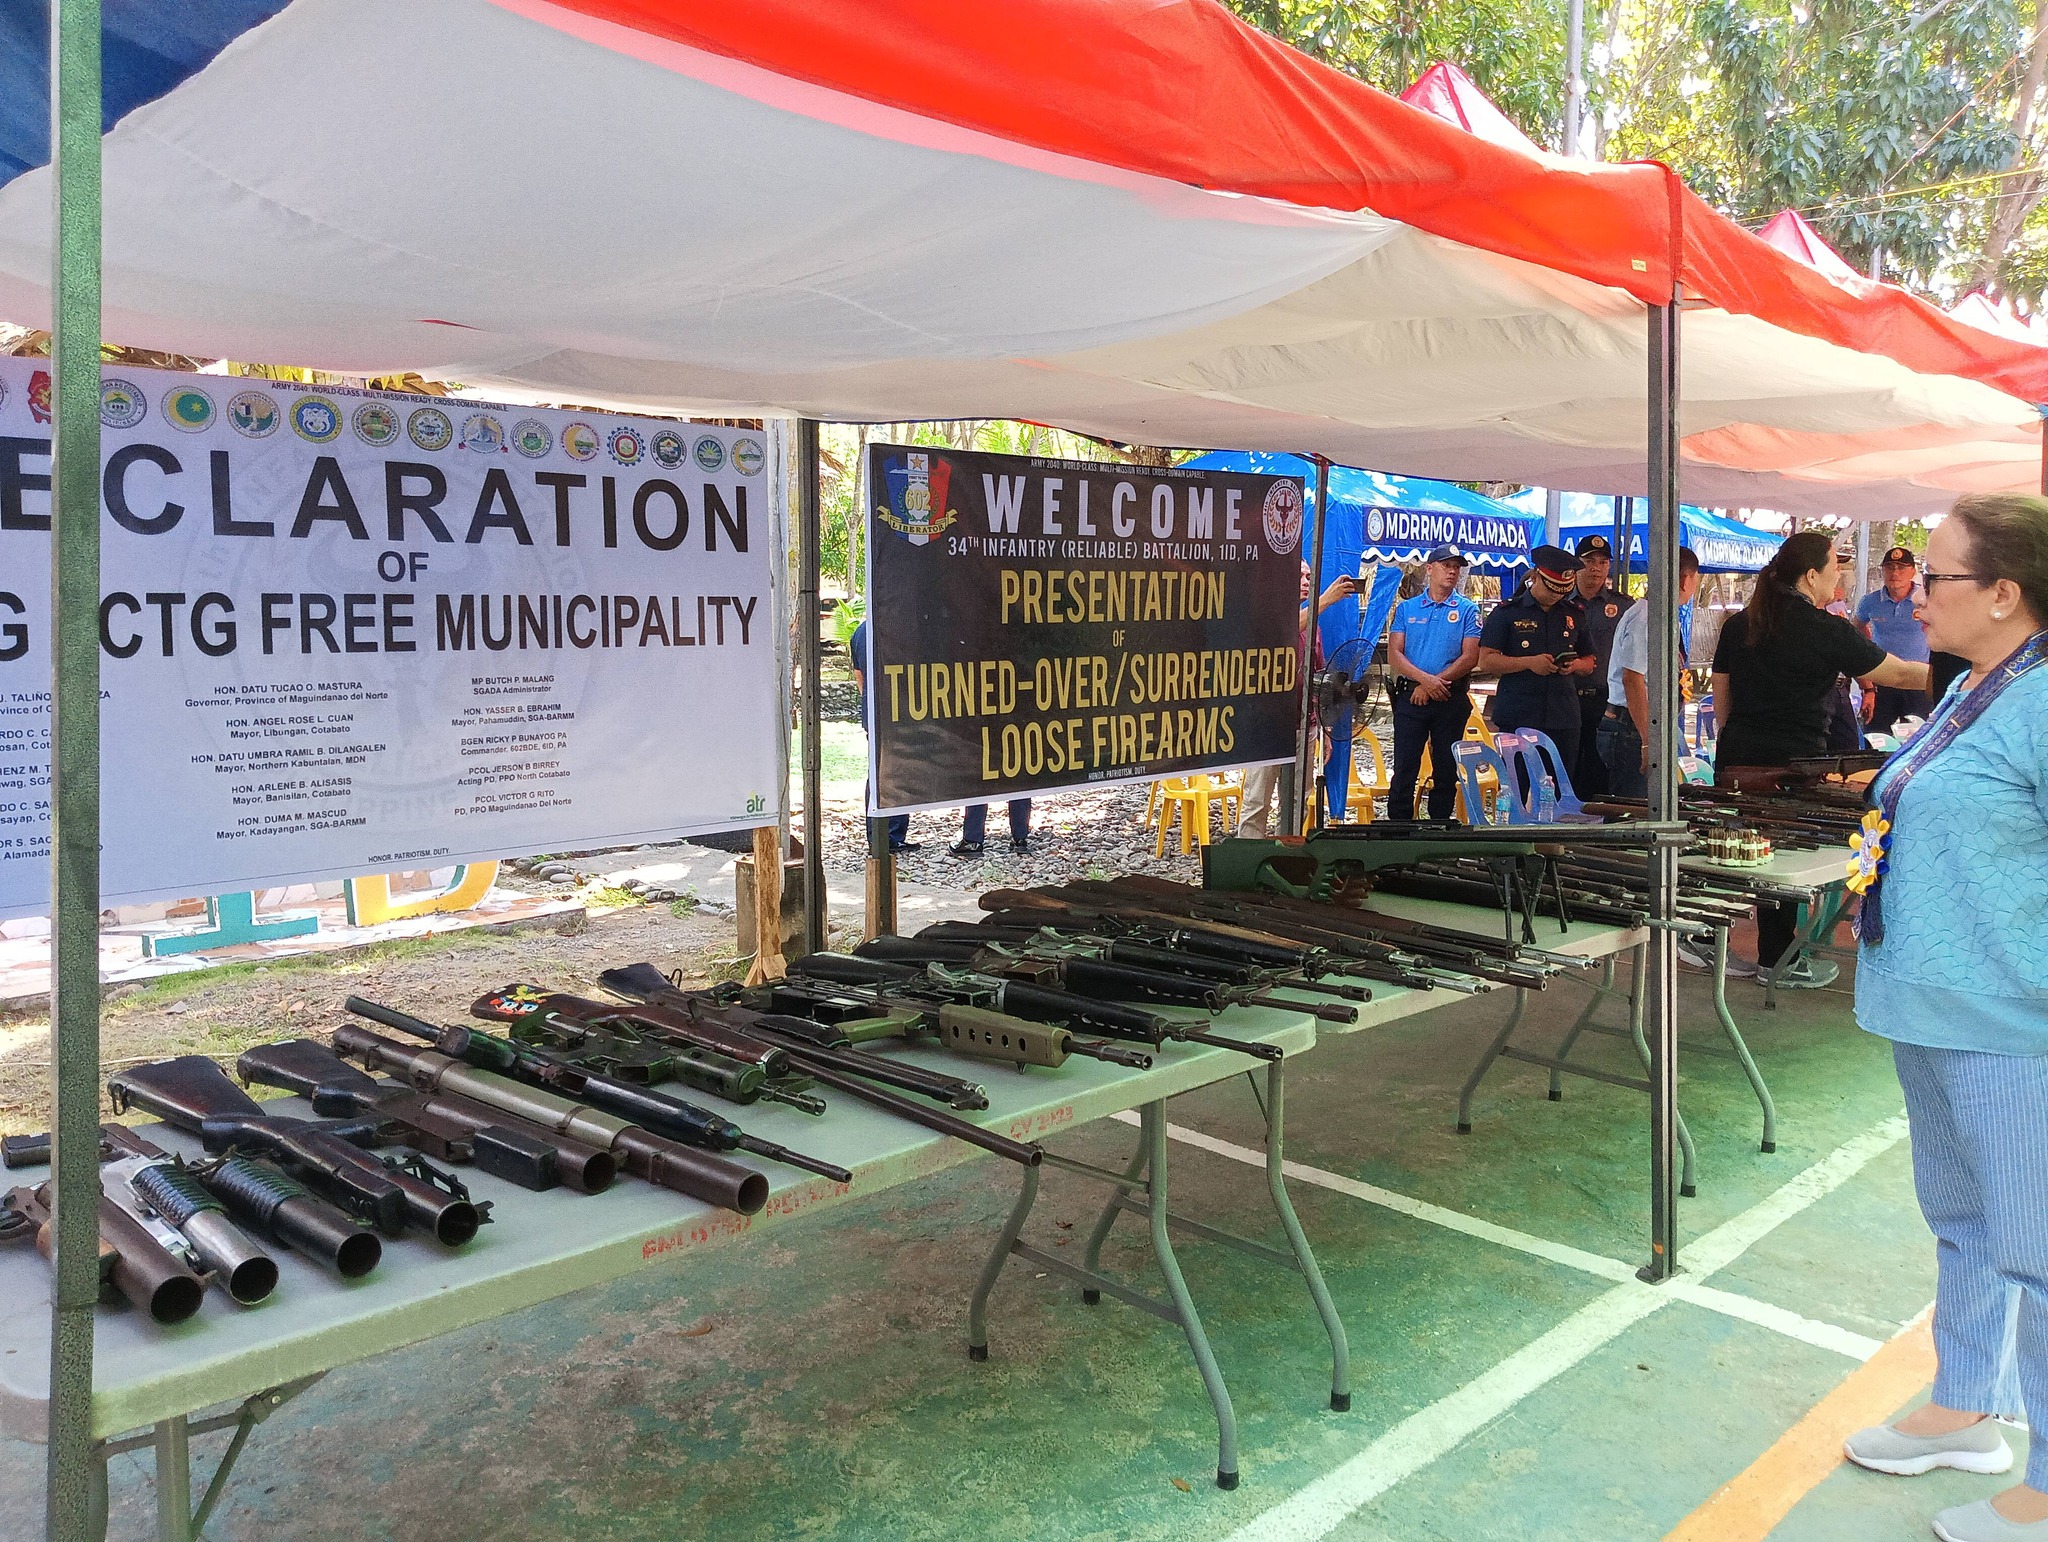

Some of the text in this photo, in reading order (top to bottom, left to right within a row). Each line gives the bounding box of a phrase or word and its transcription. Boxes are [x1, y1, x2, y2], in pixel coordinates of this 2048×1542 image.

[1031, 459, 1045, 468] ARMY
[1, 436, 748, 552] ECLARATION
[905, 489, 931, 511] 602
[982, 474, 1242, 540] WELCOME
[892, 522, 944, 533] LIBERATOR
[1385, 512, 1451, 542] MDRRMO
[1457, 519, 1527, 549] ALAMADA
[948, 537, 1259, 561] 34TH INFANTRY (RELIABLE) BATTALION, 1ID, PA
[378, 551, 429, 582] OF
[1001, 570, 1226, 625] PRESENTATION
[99, 591, 237, 658] CTG
[261, 592, 416, 653] FREE
[436, 593, 757, 652] MUNICIPALITY
[1112, 630, 1125, 647] OF
[523, 675, 554, 683] MALANG
[884, 646, 1296, 722] TURNED-OVER/SURRENDERED
[214, 686, 238, 694] HON.
[242, 685, 267, 694] DATU
[305, 684, 315, 692] O.
[318, 682, 362, 691] MASTURA
[185, 698, 232, 707] Governor,
[235, 696, 275, 705] Province
[290, 694, 348, 704] Maguindanao
[366, 692, 388, 700] Norte
[33, 705, 42, 713] of
[527, 704, 561, 712] EBRAHIM
[226, 720, 250, 728] HON.
[253, 718, 286, 726] ANGEL
[289, 716, 314, 724] ROSE
[327, 714, 354, 722] CUAN
[452, 719, 476, 727] Mayor,
[528, 713, 575, 721] SGA-BARMM
[231, 725, 350, 740] Mayor, Libungan, Cotabato
[519, 733, 555, 742] BUNAYOG
[981, 705, 1234, 780] LOOSE FIREARMS
[191, 755, 215, 763] HON.
[219, 753, 245, 761] DATU
[248, 751, 282, 759] UMBRA
[285, 749, 314, 757] RAMIL
[329, 744, 386, 754] DILANGALEN
[215, 756, 366, 774] Mayor, Northern Kabuntalan, MDN
[492, 765, 523, 773] JERSON
[533, 761, 560, 769] BIRREY
[232, 785, 255, 793] HON.
[258, 782, 296, 792] ARLENE
[310, 778, 352, 787] ALISASIS
[458, 778, 482, 786] Acting
[232, 789, 351, 805] Mayor, Banisilan, Cotabato
[499, 793, 527, 801] VICTOR
[454, 808, 468, 816] PD,
[470, 806, 486, 814] PPO
[489, 802, 537, 812] Maguindanao
[264, 815, 292, 824] DUMA
[294, 813, 304, 821] M.
[307, 810, 347, 820] MASCUD
[216, 818, 366, 839] Mayor, Kadayangan, SGA-BARMM
[16, 839, 26, 847] S.
